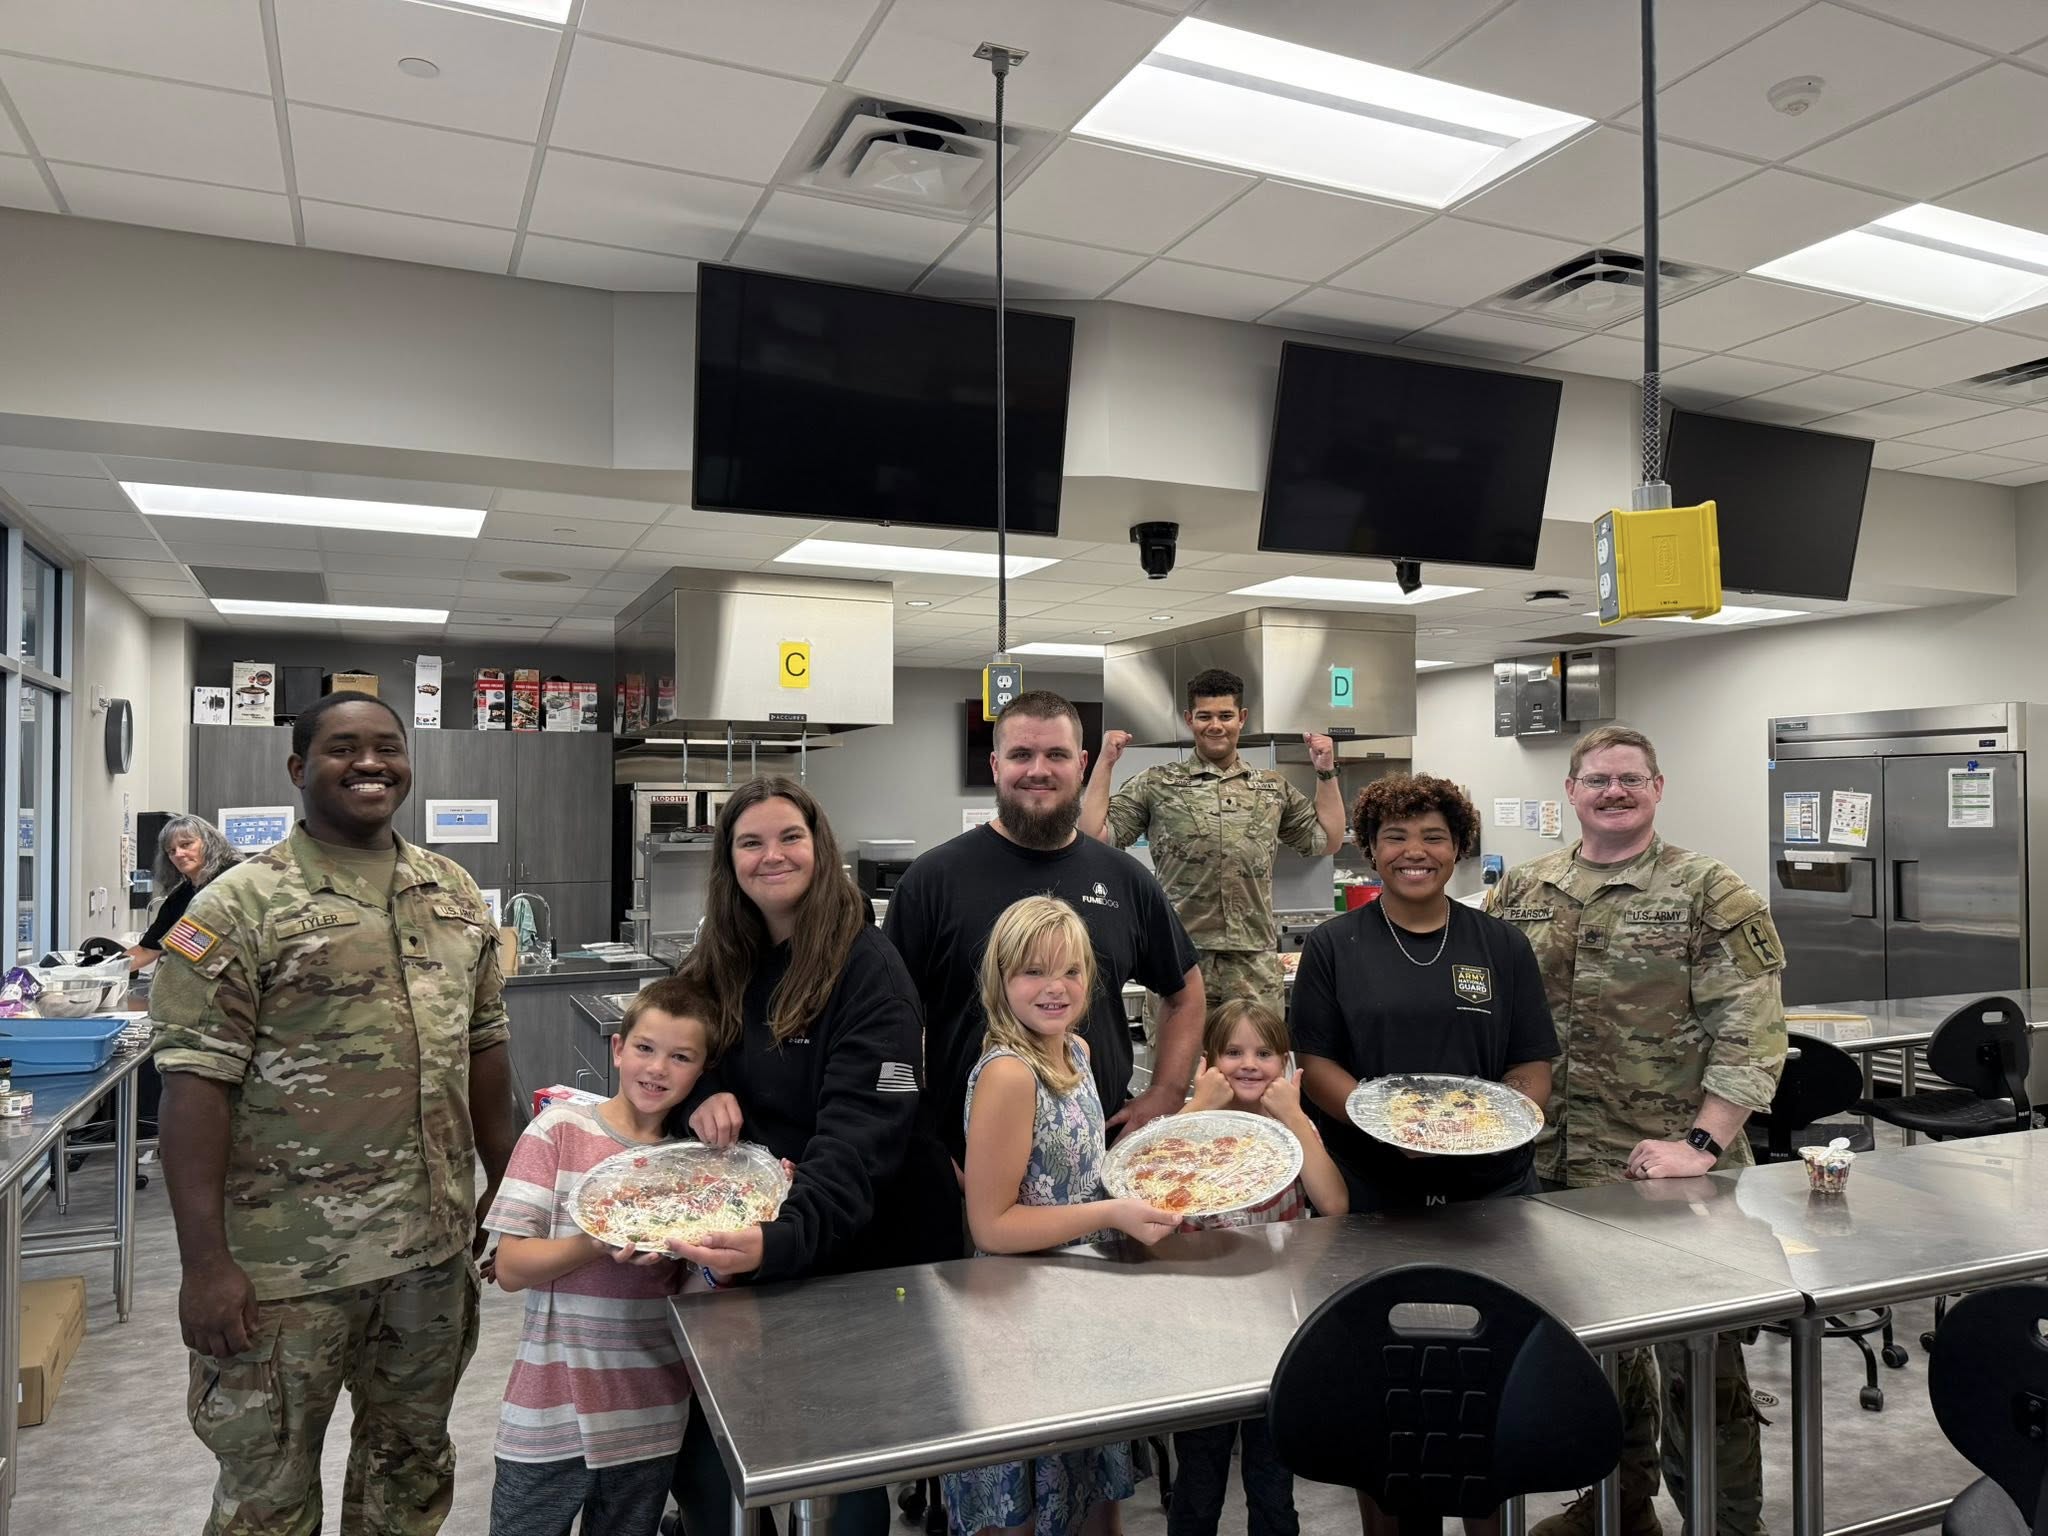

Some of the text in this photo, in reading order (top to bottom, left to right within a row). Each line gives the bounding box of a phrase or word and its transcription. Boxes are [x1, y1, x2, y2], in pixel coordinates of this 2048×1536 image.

[785, 652, 806, 676] C
[1334, 675, 1349, 696] D
[440, 906, 458, 916] U.S.
[1510, 908, 1549, 918] PEARSON
[1633, 910, 1681, 921] U.S. ARMY
[298, 914, 339, 930] TYLER
[1458, 972, 1485, 981] ARMY
[1458, 983, 1487, 992] GUARD
